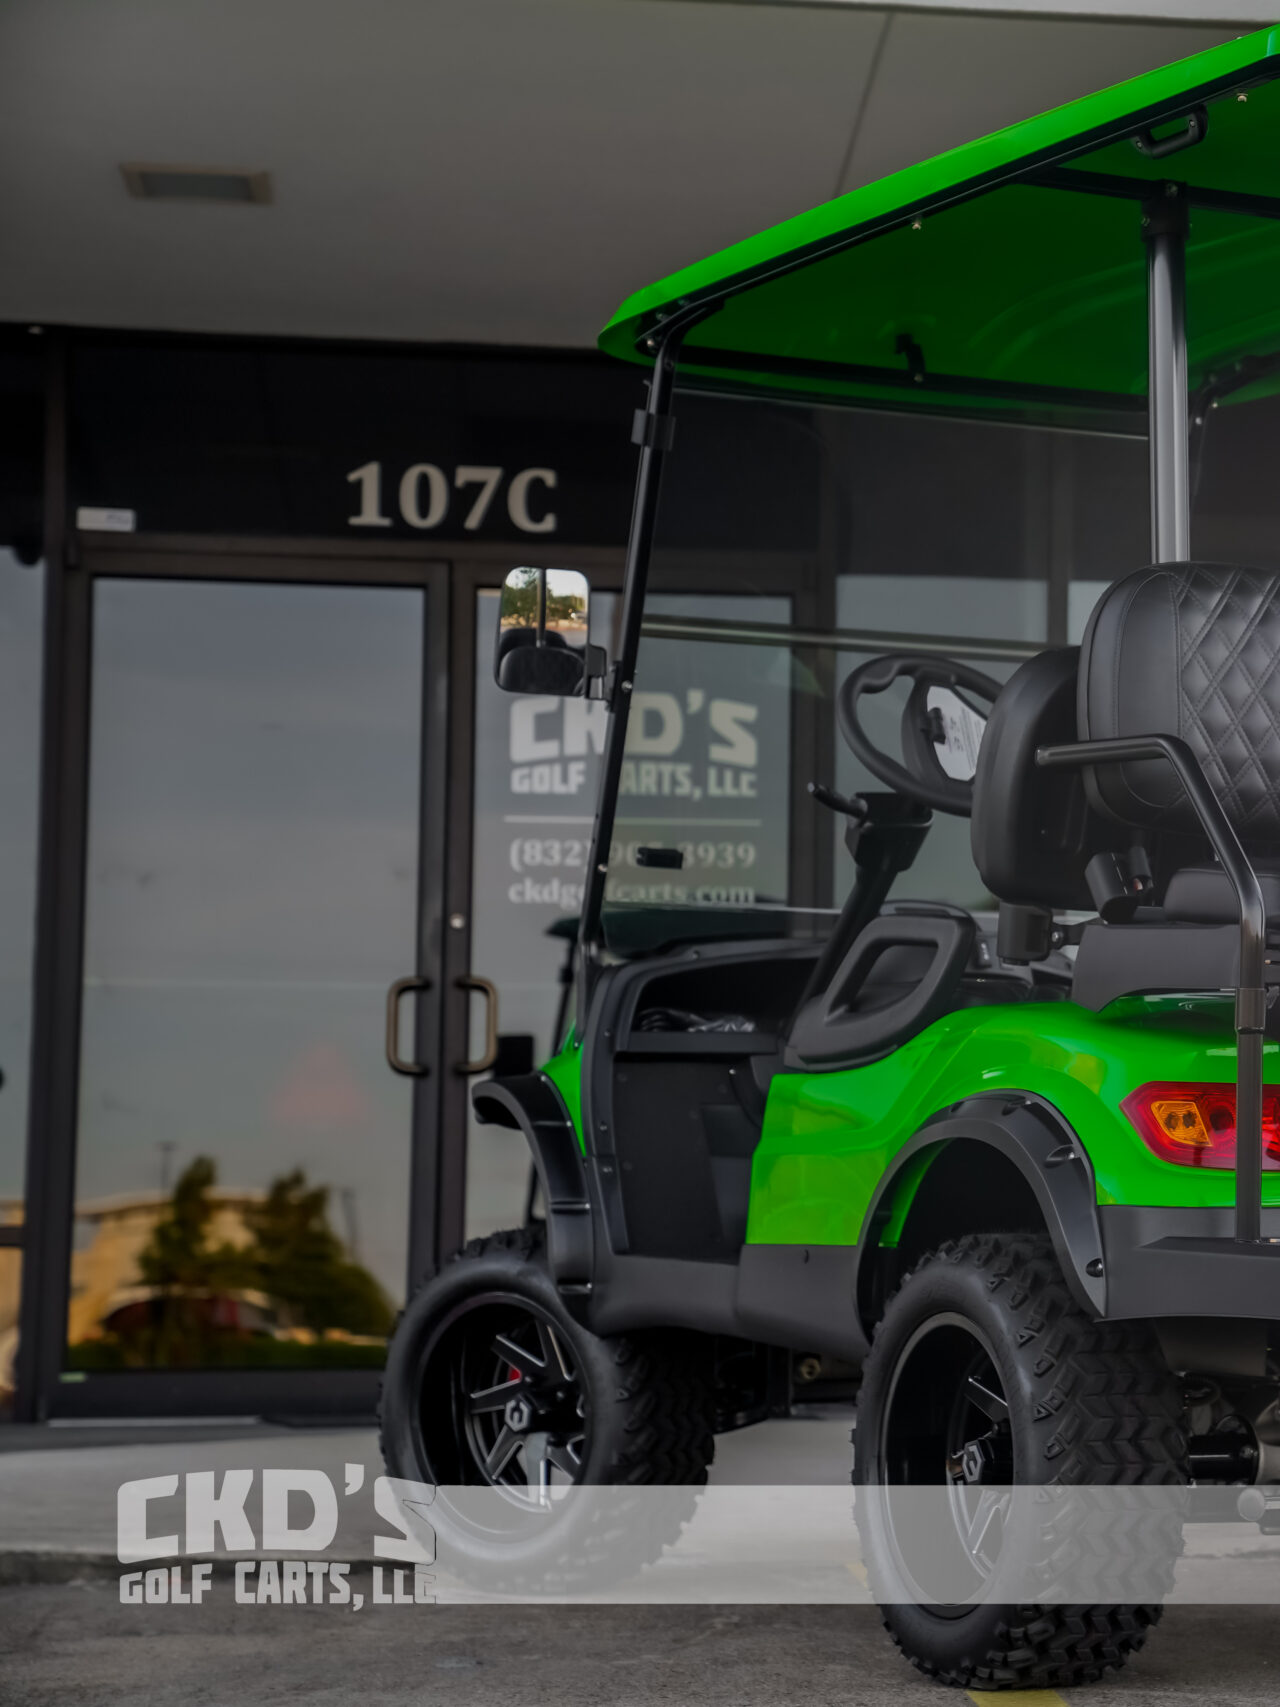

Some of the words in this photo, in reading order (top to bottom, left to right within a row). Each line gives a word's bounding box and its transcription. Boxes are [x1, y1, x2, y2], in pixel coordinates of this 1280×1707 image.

[344, 461, 556, 532] 107C
[511, 689, 757, 767] CKD'S
[511, 762, 586, 794] GOLF
[619, 763, 702, 799] ARTS,
[708, 767, 757, 797] LLC
